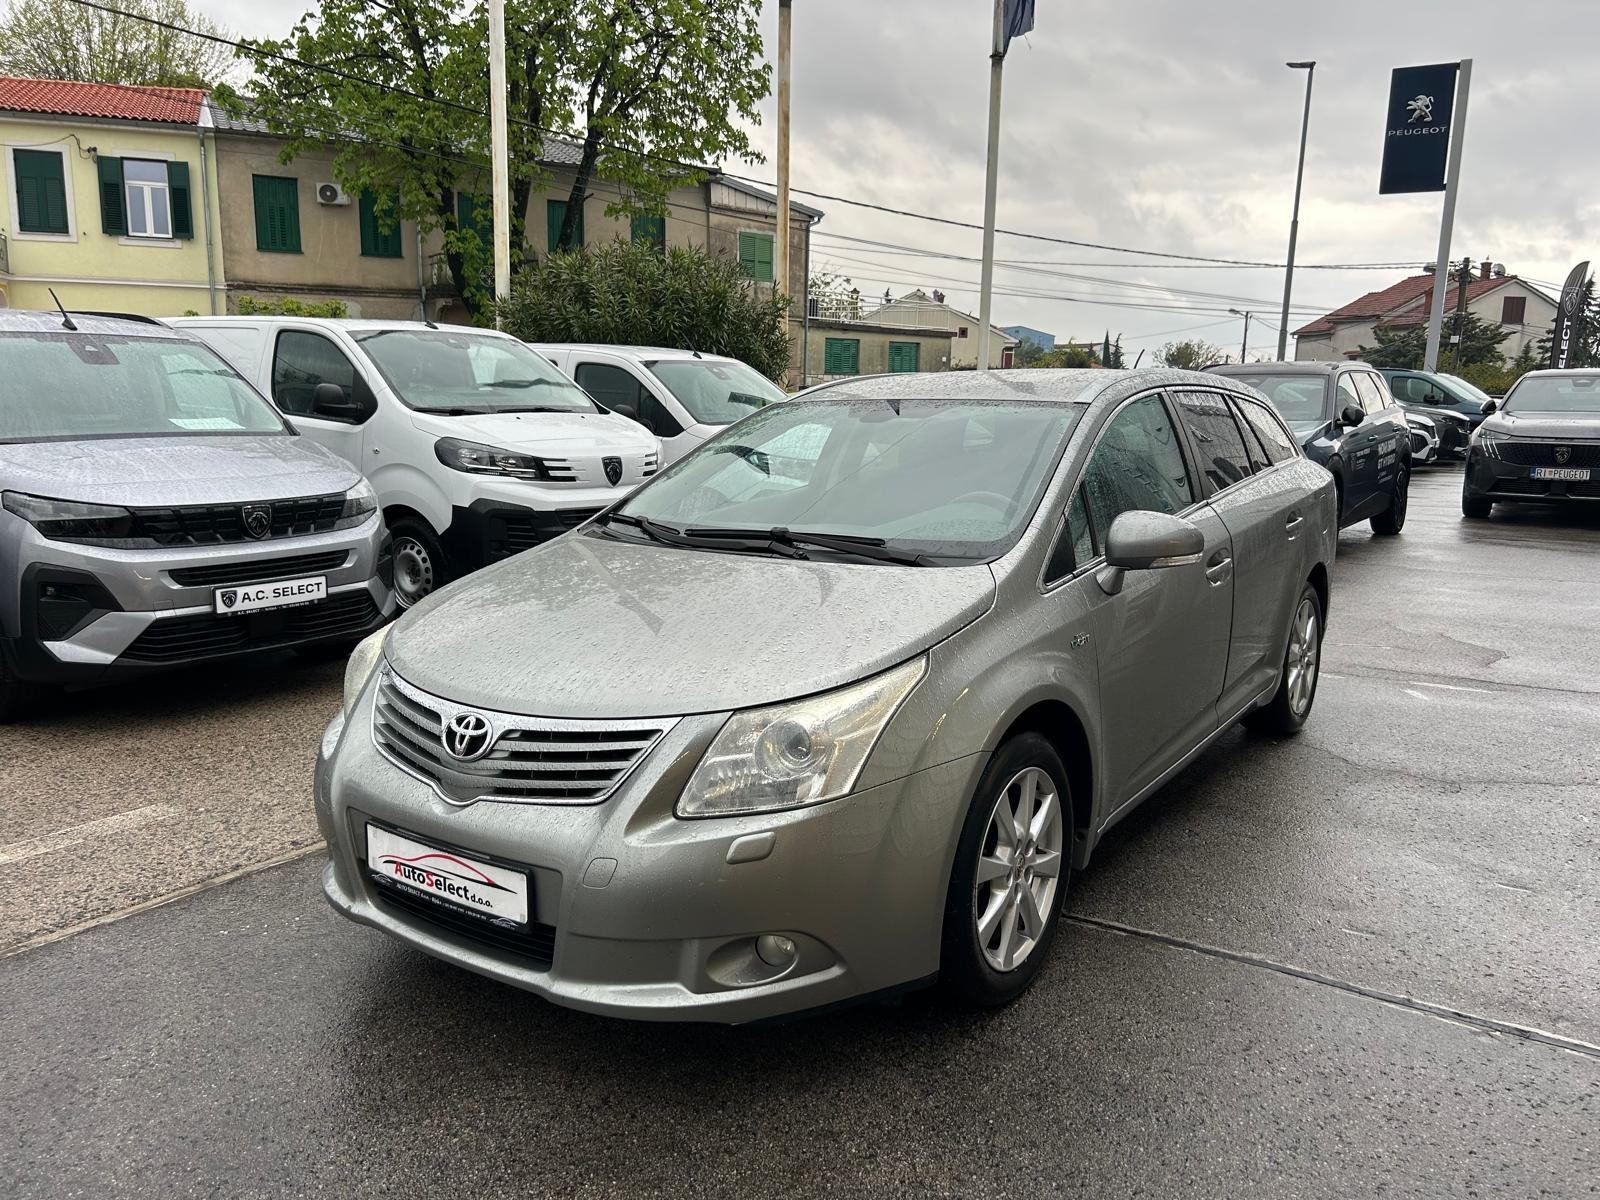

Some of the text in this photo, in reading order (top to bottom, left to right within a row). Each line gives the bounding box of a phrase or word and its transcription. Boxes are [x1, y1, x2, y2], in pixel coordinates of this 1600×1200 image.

[1388, 126, 1447, 137] PEUGEOT
[1558, 317, 1572, 369] ELECT
[1553, 469, 1590, 480] PEUGEOT
[241, 582, 322, 603] A.C. SELECT
[394, 862, 471, 901] AutoSelect
[470, 893, 493, 908] d.o.o.
